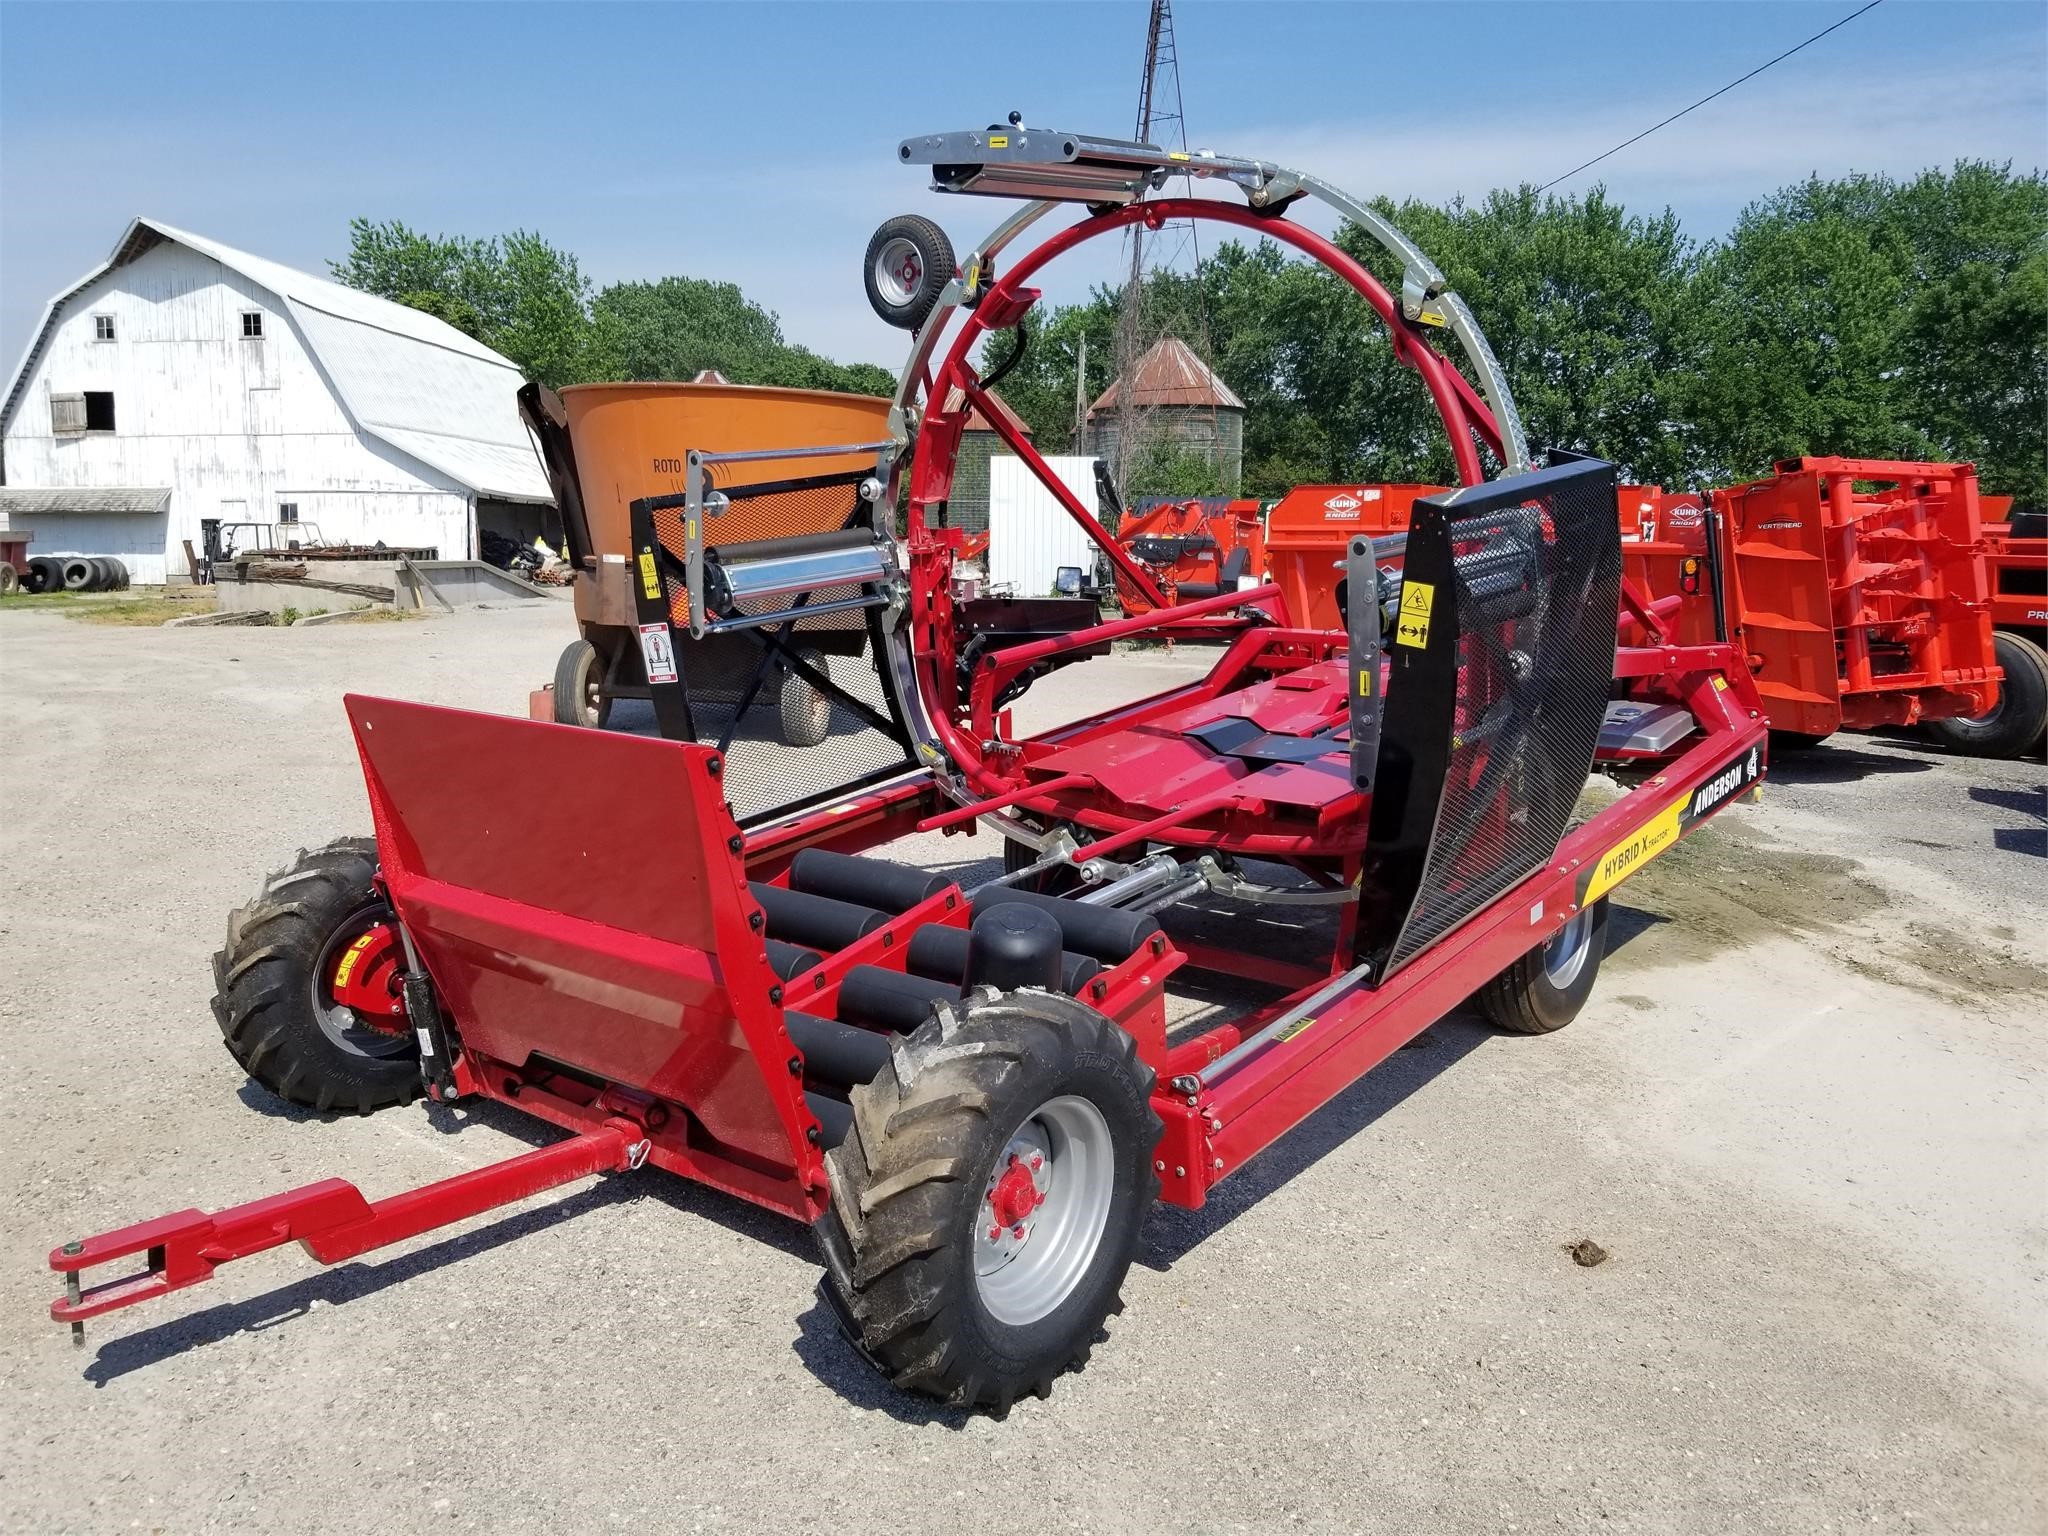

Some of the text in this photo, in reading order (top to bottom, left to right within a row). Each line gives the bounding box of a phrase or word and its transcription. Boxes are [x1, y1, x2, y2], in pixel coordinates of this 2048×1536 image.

[653, 458, 682, 473] ROTO
[1329, 500, 1357, 508] KUHN
[1693, 764, 1742, 817] ANDERSON
[1604, 842, 1640, 880] HYBRID
